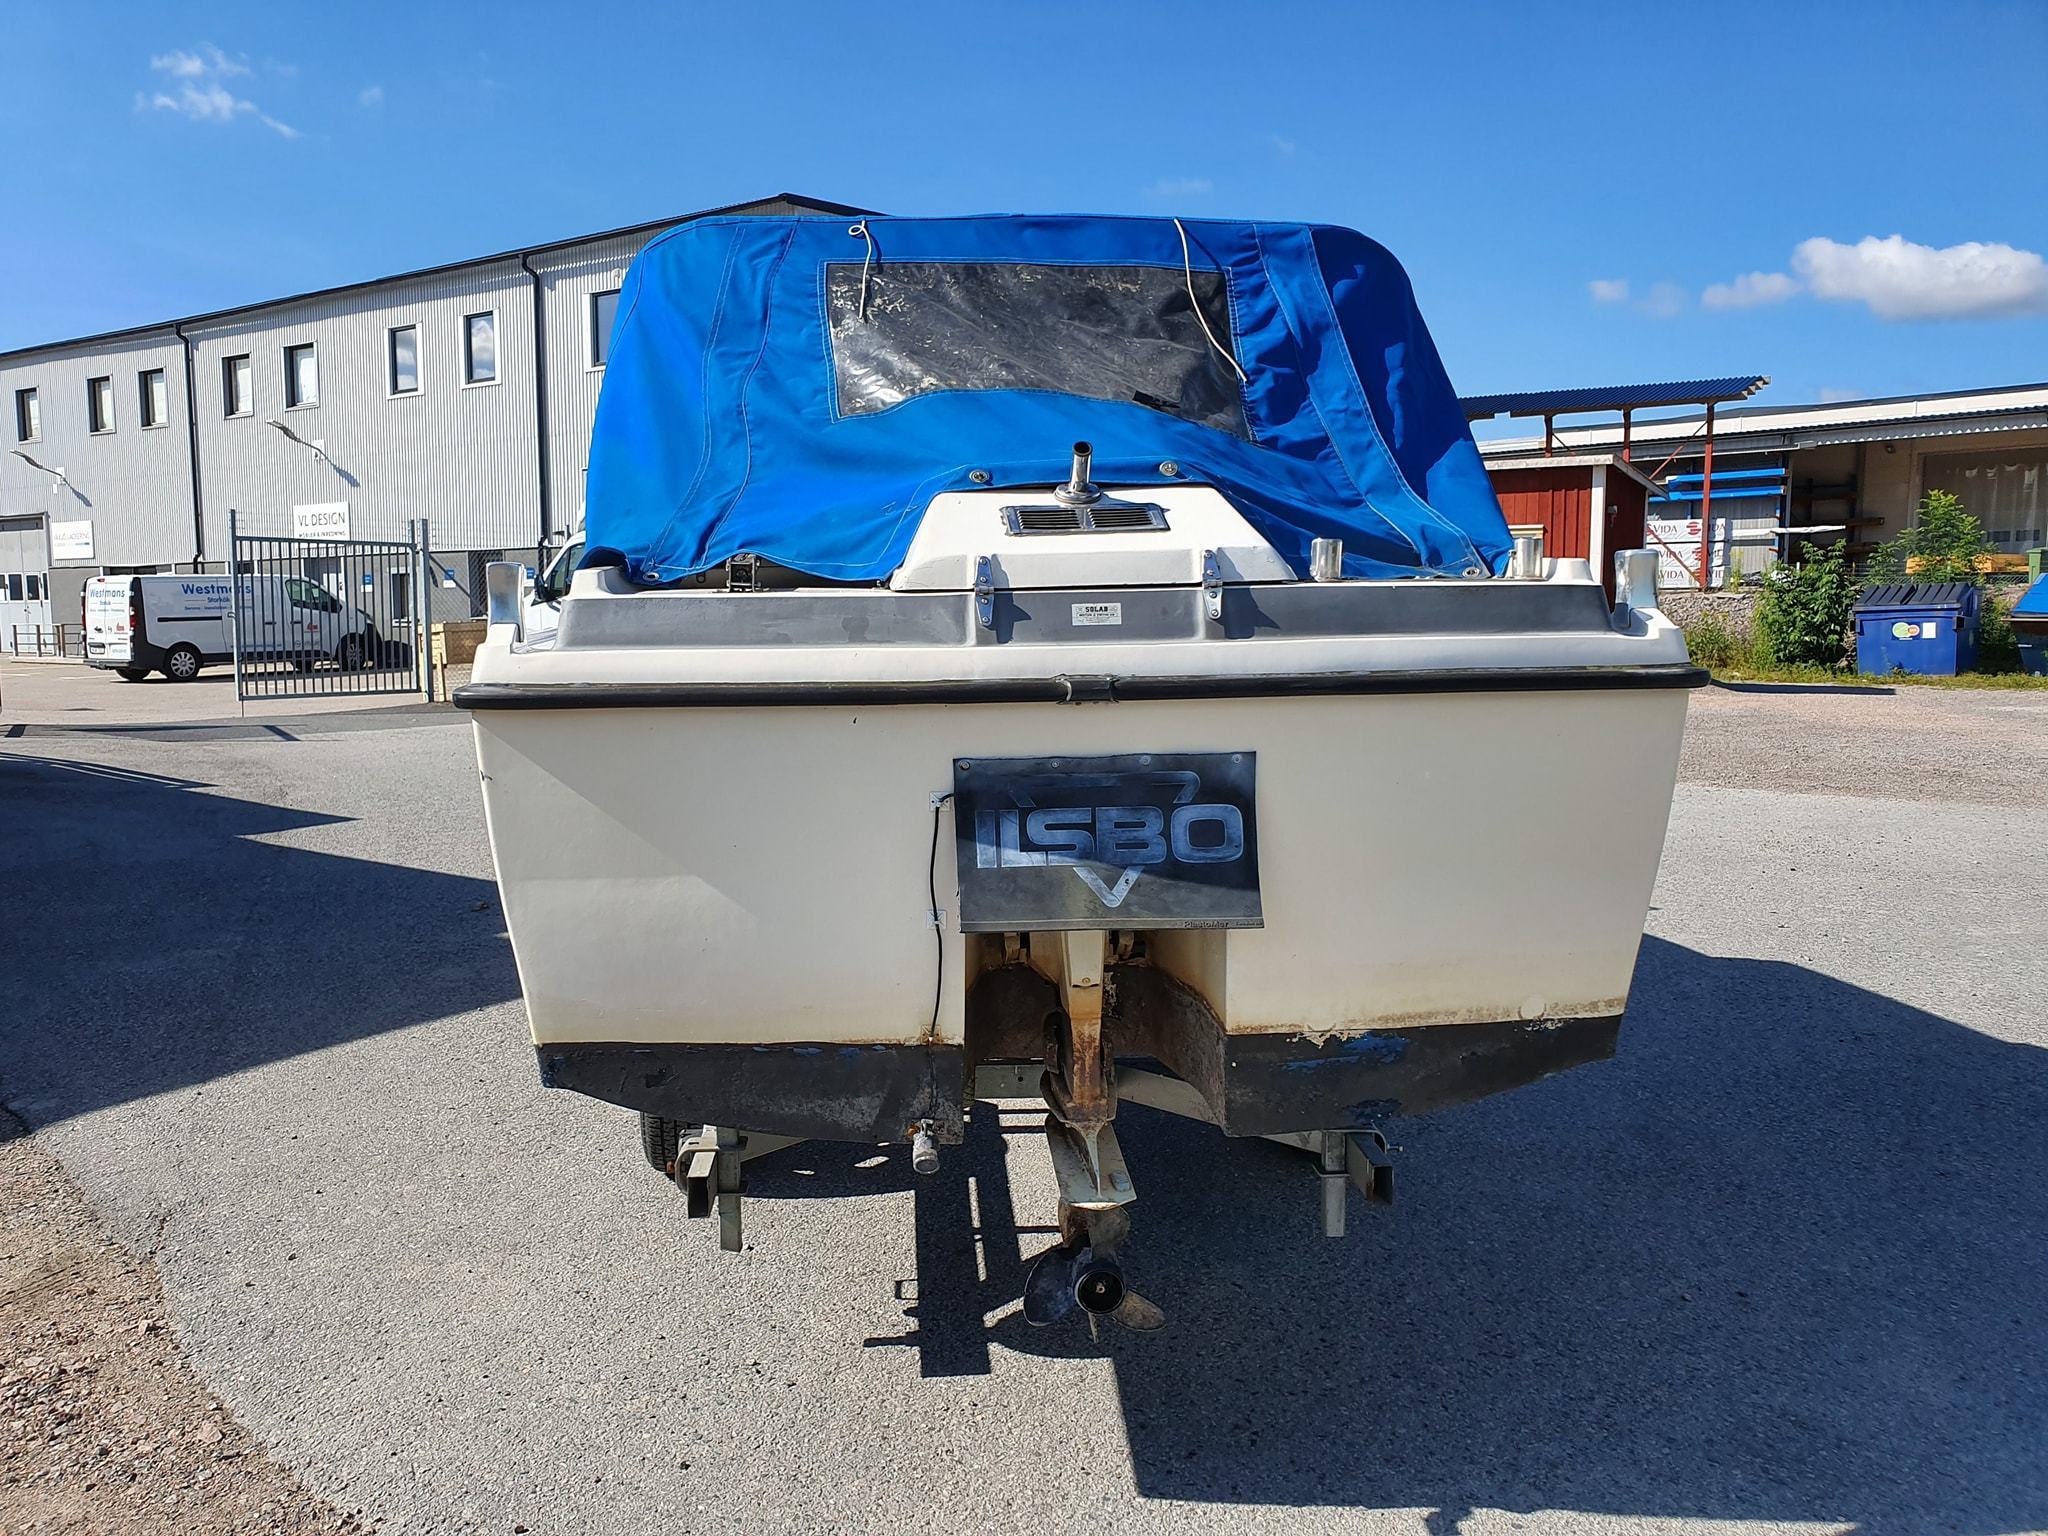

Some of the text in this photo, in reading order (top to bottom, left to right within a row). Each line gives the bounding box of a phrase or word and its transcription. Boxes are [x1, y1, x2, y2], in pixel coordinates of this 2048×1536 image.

[298, 512, 345, 526] VL DESIGN
[1653, 525, 1678, 534] VIDA
[1658, 550, 1683, 559] VIA
[90, 589, 125, 598] Westmans
[181, 584, 252, 595] Westms
[975, 803, 1244, 869] ILSBO
